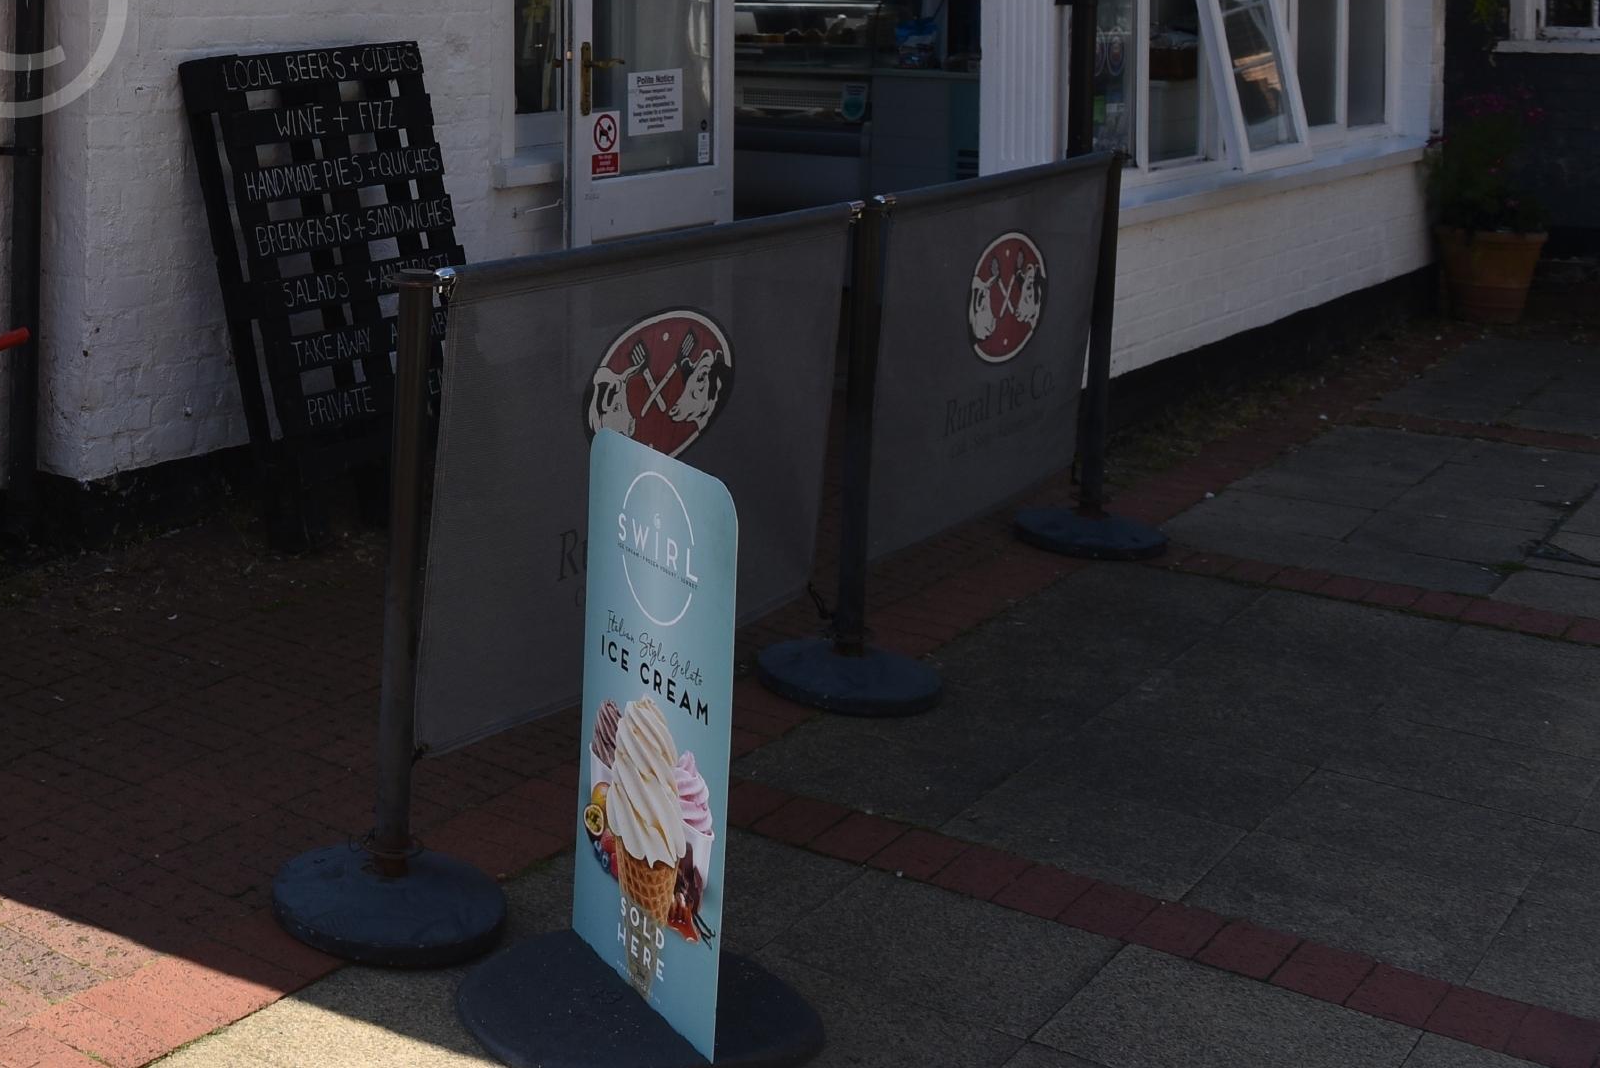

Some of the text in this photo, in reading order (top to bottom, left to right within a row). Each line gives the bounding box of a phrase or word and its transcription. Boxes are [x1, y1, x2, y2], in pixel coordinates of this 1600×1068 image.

[222, 58, 281, 91] LOCAL
[285, 51, 347, 82] BEERS
[362, 43, 421, 74] CIDERS
[636, 75, 675, 85] Polite Notice
[273, 99, 398, 137] WINE + FIZZ
[244, 163, 322, 202] HANDMADE
[322, 154, 364, 187] PIES
[378, 146, 440, 177] QUICHES
[255, 213, 351, 257] BREAKFASTS
[366, 197, 452, 236] SANDWICHES
[282, 271, 350, 308] SALADS
[307, 386, 377, 427] PRIVATE
[943, 383, 992, 437] Rural
[998, 375, 1025, 416] Pie
[618, 512, 698, 584] SWIRL
[606, 609, 704, 686] Italian Style Gelato
[601, 634, 709, 726] ICE CREAM
[620, 896, 665, 950] SOLD
[617, 922, 665, 982] HERE
